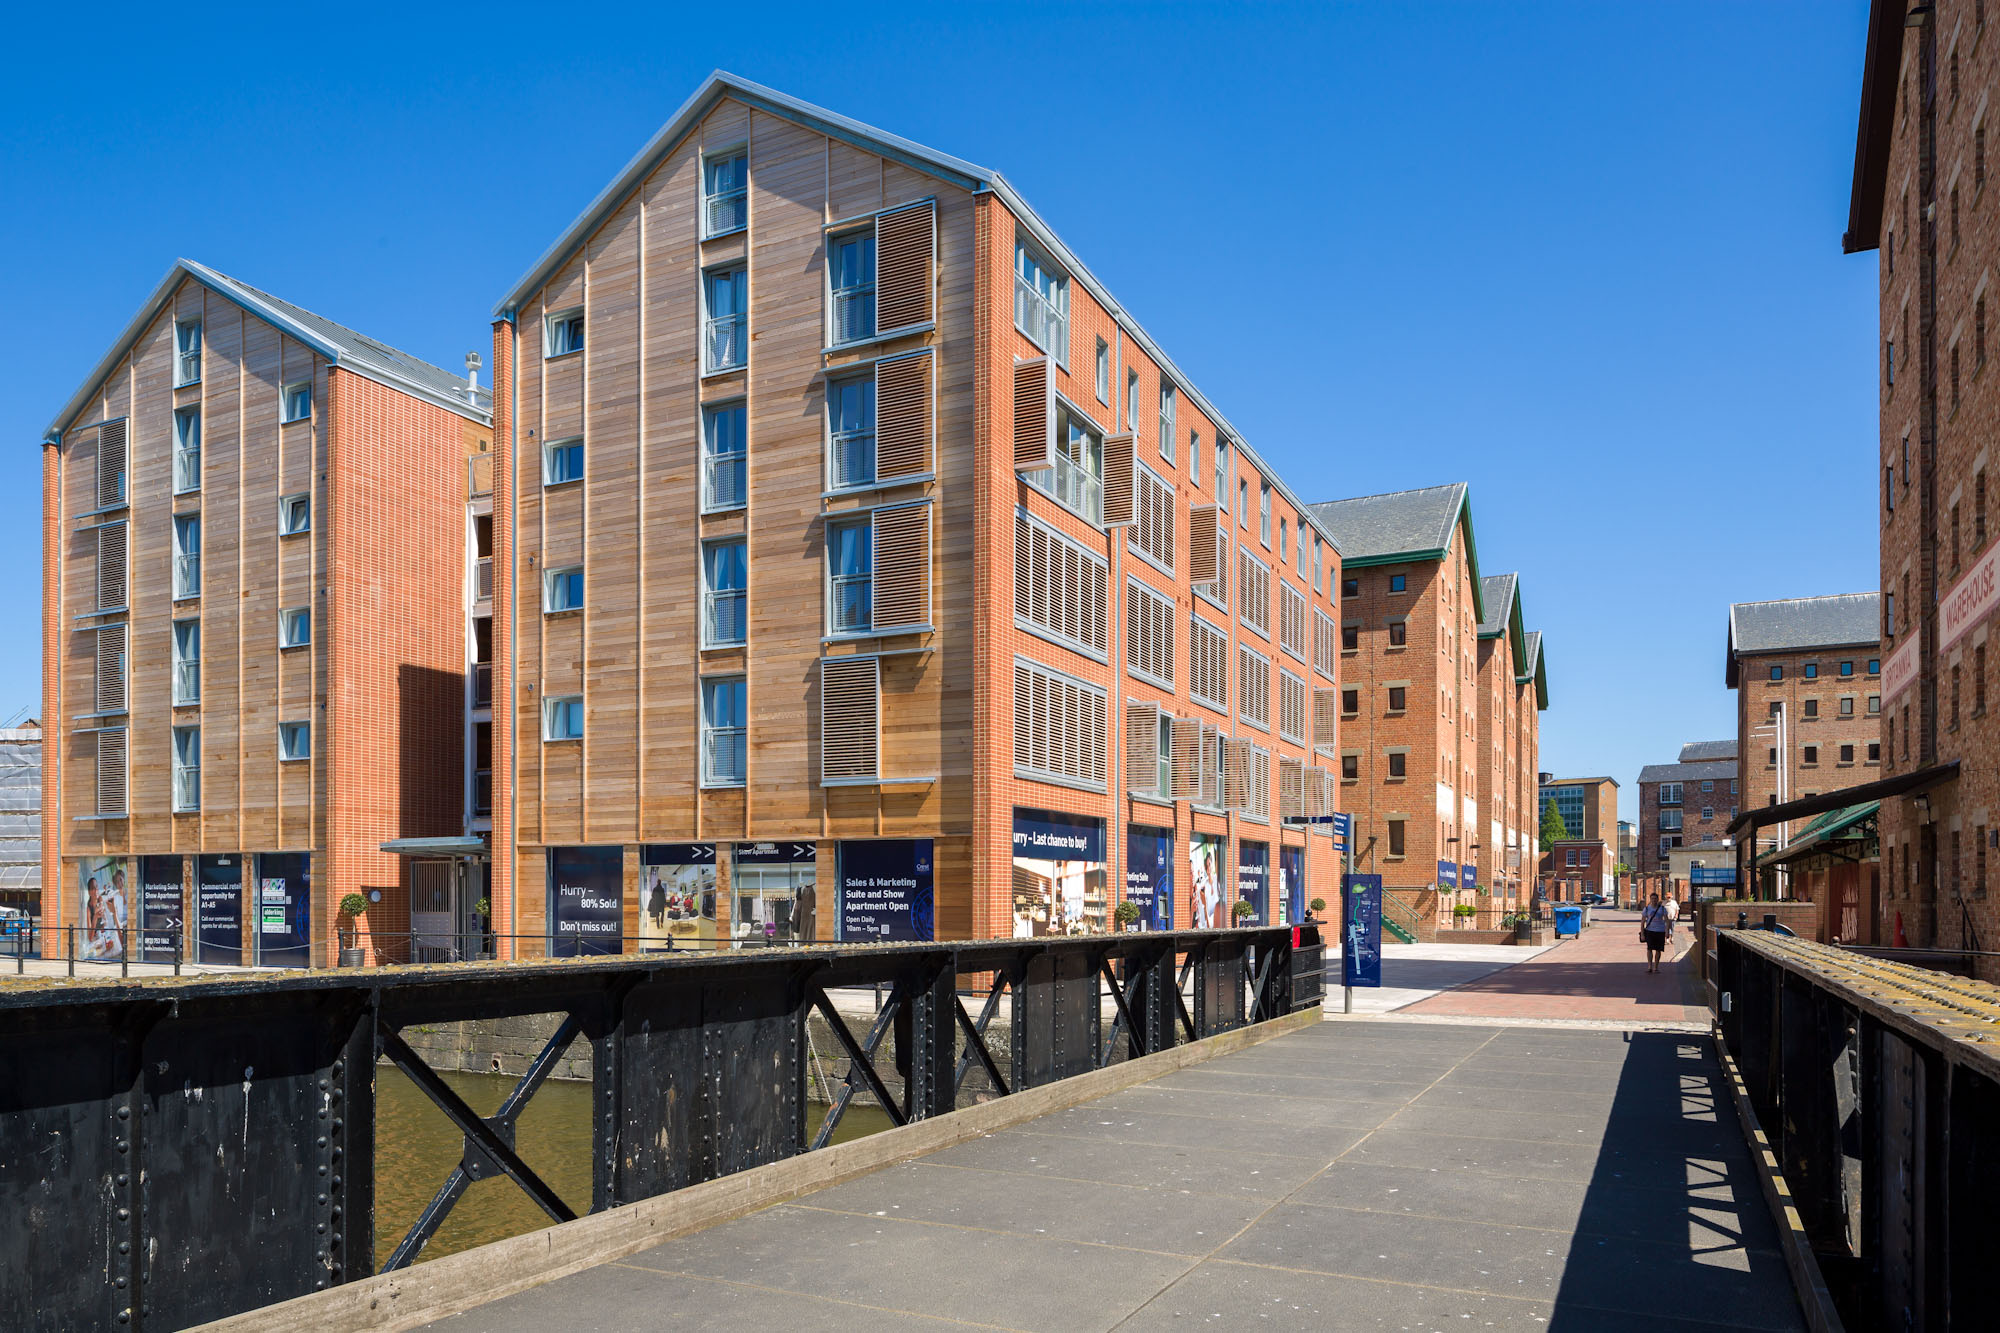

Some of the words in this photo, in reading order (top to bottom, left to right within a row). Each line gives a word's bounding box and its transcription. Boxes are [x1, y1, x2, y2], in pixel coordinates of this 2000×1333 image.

[1886, 647, 1912, 692] BRITANNIA
[1946, 558, 1995, 633] WAREHOUSE
[1033, 831, 1047, 846] Last
[1047, 833, 1068, 847] chance
[1068, 835, 1075, 848] to
[1075, 835, 1087, 852] buy!
[1139, 872, 1149, 882] Suite
[145, 883, 167, 891] Marketing
[846, 878, 867, 887] Sales
[869, 878, 875, 887] &
[877, 878, 917, 888] Marketing
[560, 884, 587, 898] Hurry
[846, 890, 866, 899] Suite
[867, 890, 881, 899] and
[883, 890, 904, 899] Show
[1135, 884, 1153, 896] Apartment
[157, 892, 180, 900] Apartment
[201, 892, 227, 900] opportunity
[227, 892, 235, 900] for
[201, 901, 216, 909] A1-A5
[581, 899, 598, 909] 80%
[599, 899, 617, 909] Sold
[846, 902, 887, 912] Apartment
[888, 902, 909, 912] Open
[861, 916, 875, 924] Daily
[560, 921, 580, 931] Don't
[581, 921, 600, 932] miss
[601, 921, 617, 932] out!
[866, 925, 879, 933] 5pm
